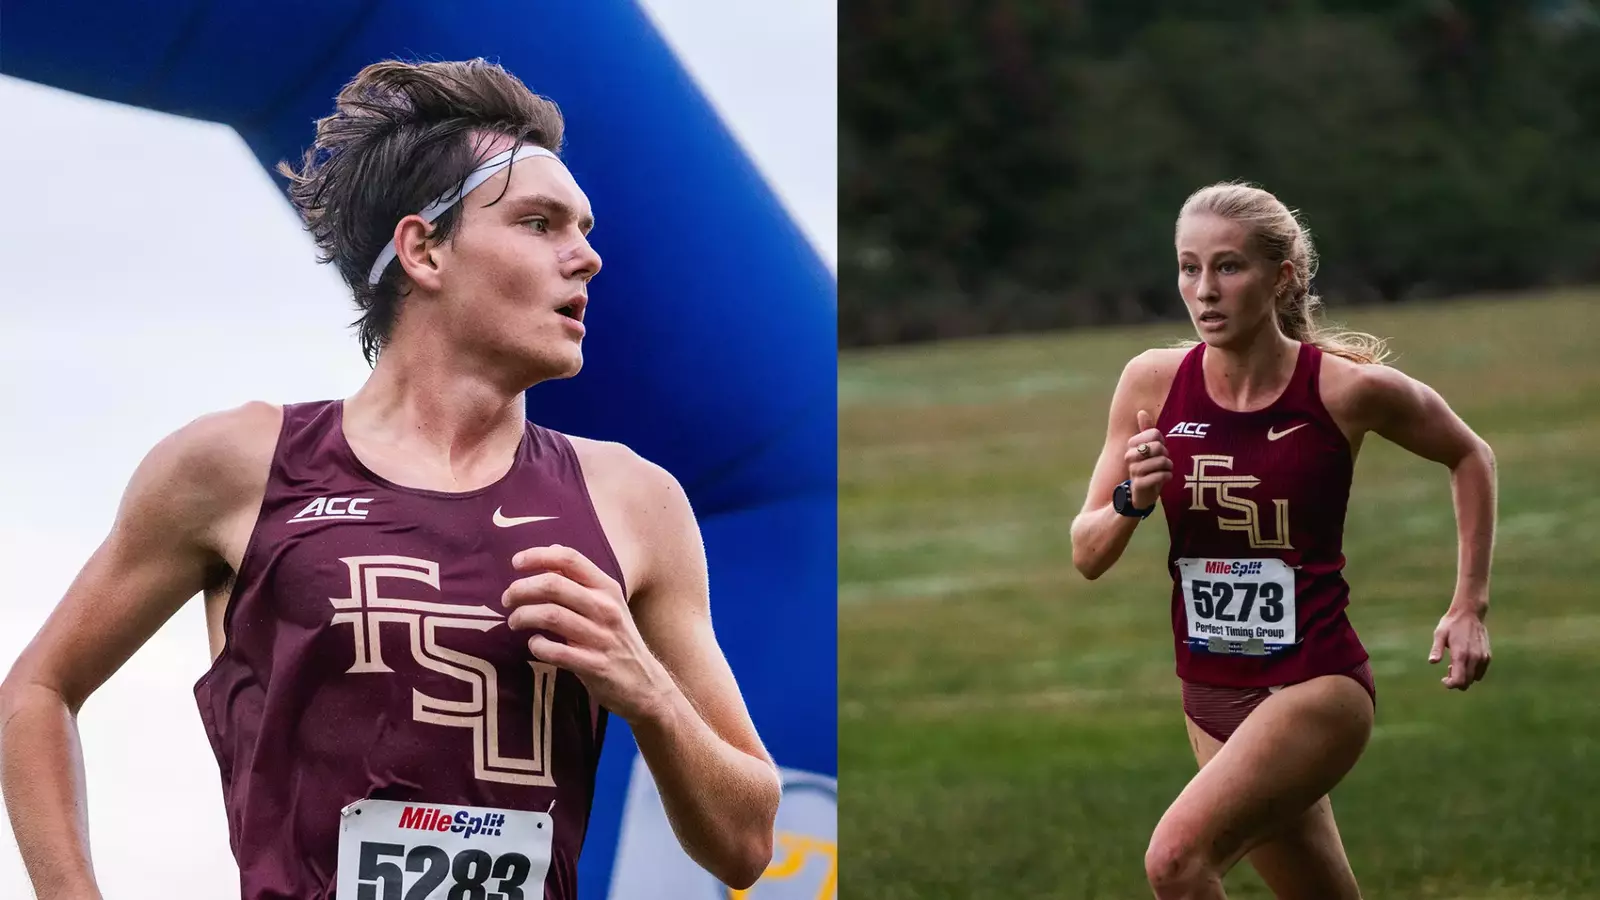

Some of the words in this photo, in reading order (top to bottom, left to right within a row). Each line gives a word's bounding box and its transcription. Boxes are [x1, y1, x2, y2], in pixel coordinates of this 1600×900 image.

[1168, 421, 1211, 436] ACC
[290, 496, 375, 518] ACC
[1183, 454, 1295, 550] FSU
[1205, 561, 1263, 577] MileSplit
[1191, 580, 1285, 623] 5273
[1195, 621, 1224, 636] Perfect
[1225, 626, 1254, 639] Timing
[1255, 626, 1285, 639] Group
[328, 555, 558, 788] FSU
[398, 806, 506, 839] MileSplit
[357, 841, 532, 900] 5283
